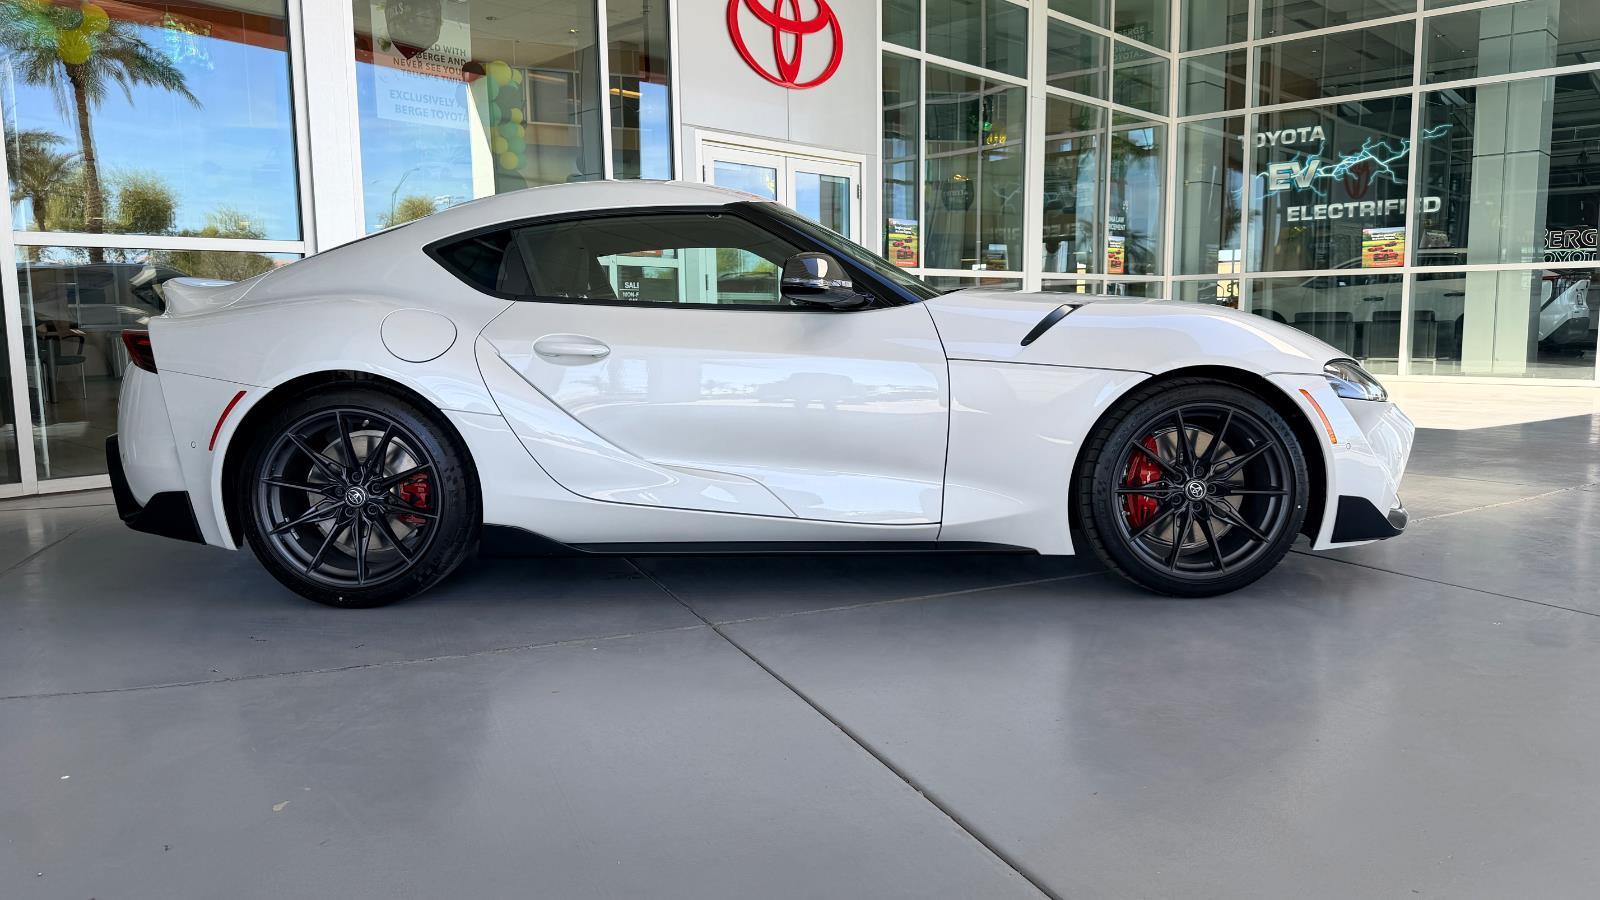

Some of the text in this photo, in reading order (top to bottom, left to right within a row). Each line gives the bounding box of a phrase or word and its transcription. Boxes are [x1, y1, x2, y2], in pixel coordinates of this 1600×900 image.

[443, 45, 466, 57] WITH
[393, 57, 462, 75] NEVER SEE YOU
[447, 57, 467, 66] AND
[389, 89, 455, 107] EXCLUSIVELY
[394, 104, 430, 117] BERGE
[1269, 159, 1320, 190] EV
[1287, 196, 1442, 222] ELECTRIFID
[1544, 228, 1598, 249] ERG
